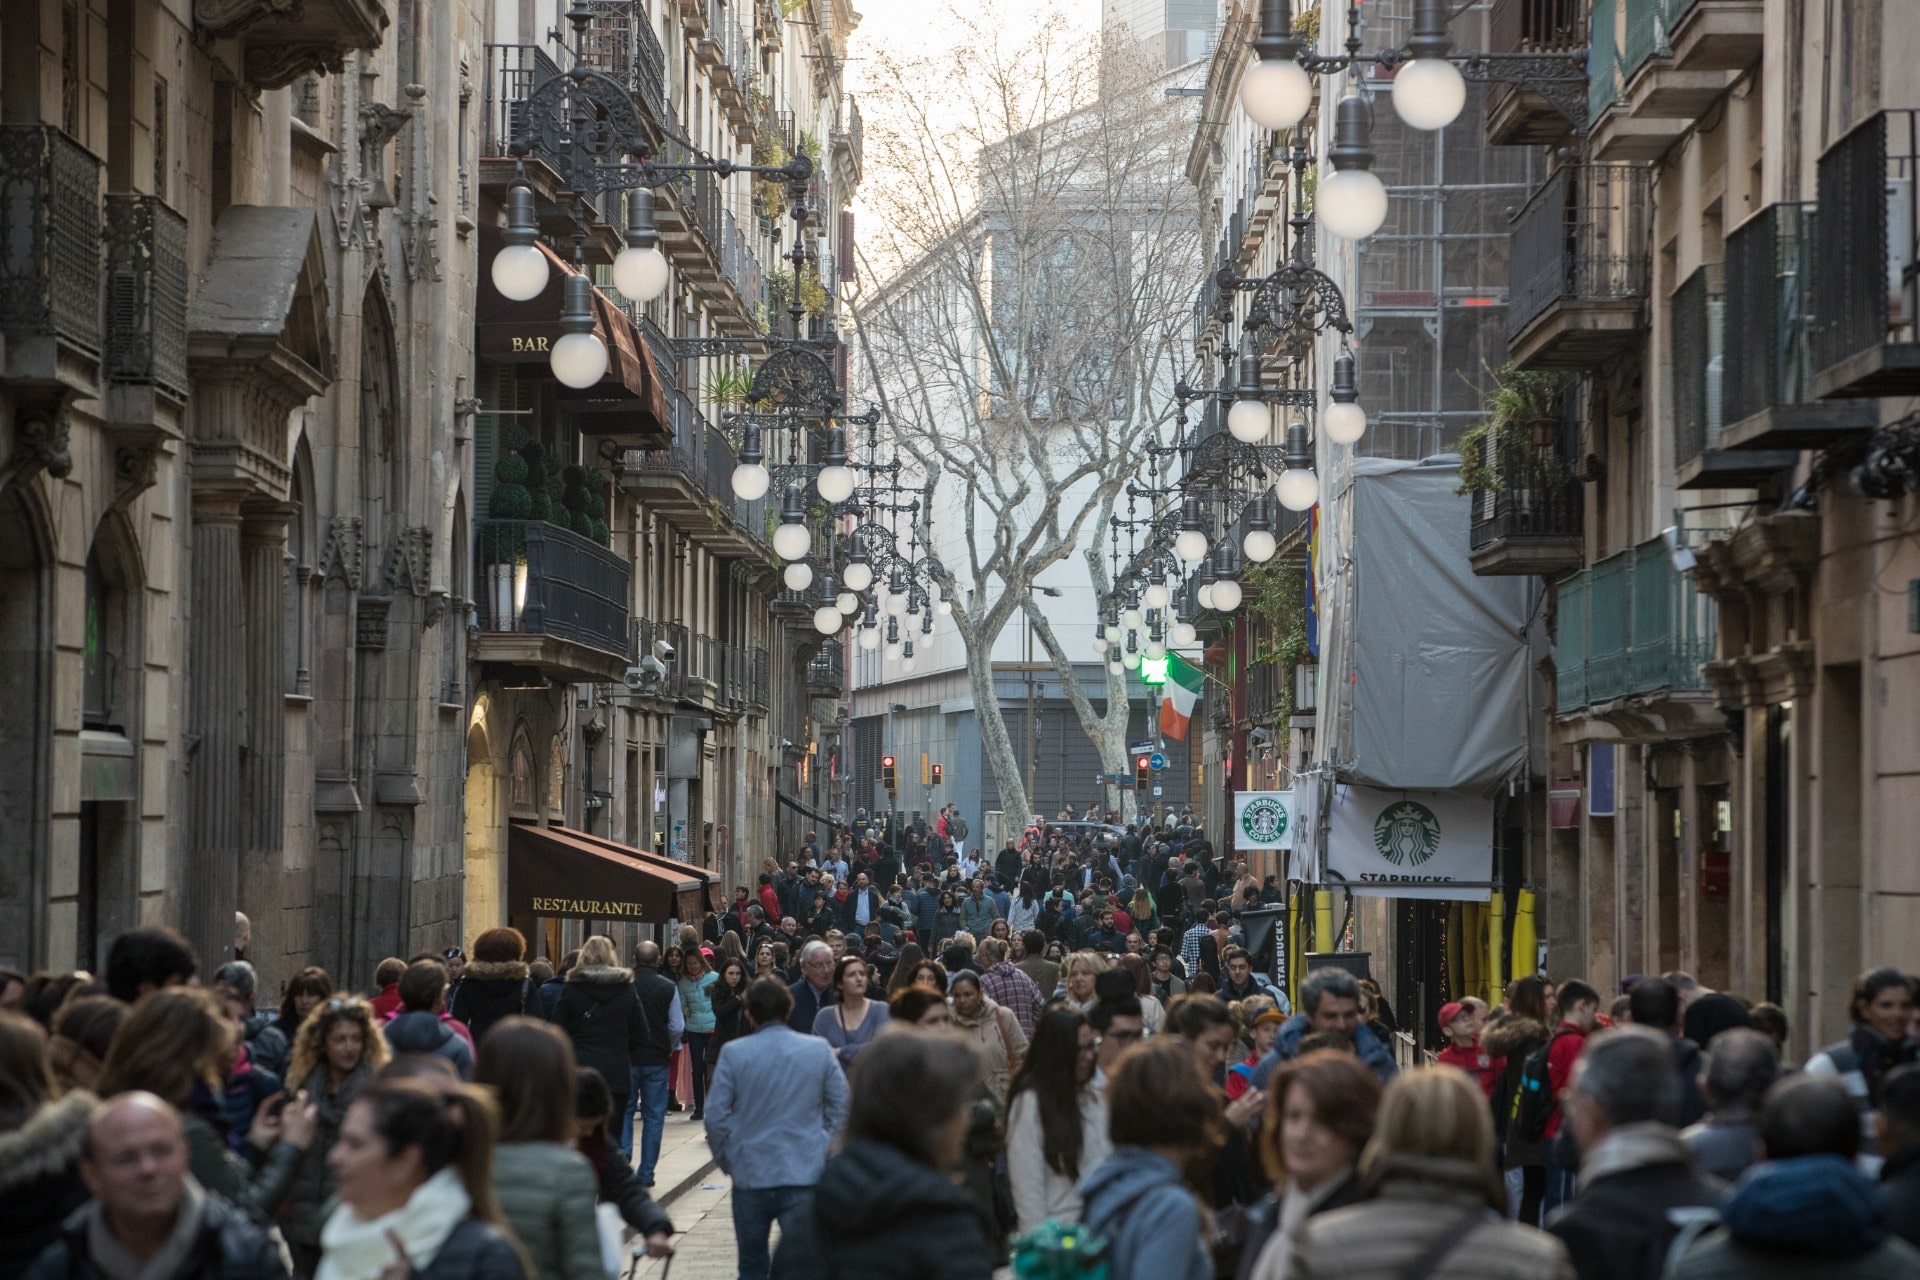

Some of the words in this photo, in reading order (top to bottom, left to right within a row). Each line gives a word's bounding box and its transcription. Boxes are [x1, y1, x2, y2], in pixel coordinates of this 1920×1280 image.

[511, 336, 550, 352] BAR
[1244, 799, 1286, 819] STARBUCKS
[1248, 829, 1281, 842] COFFEE
[532, 897, 643, 916] RESTAURANTE
[1275, 920, 1286, 987] STARBUCKS
